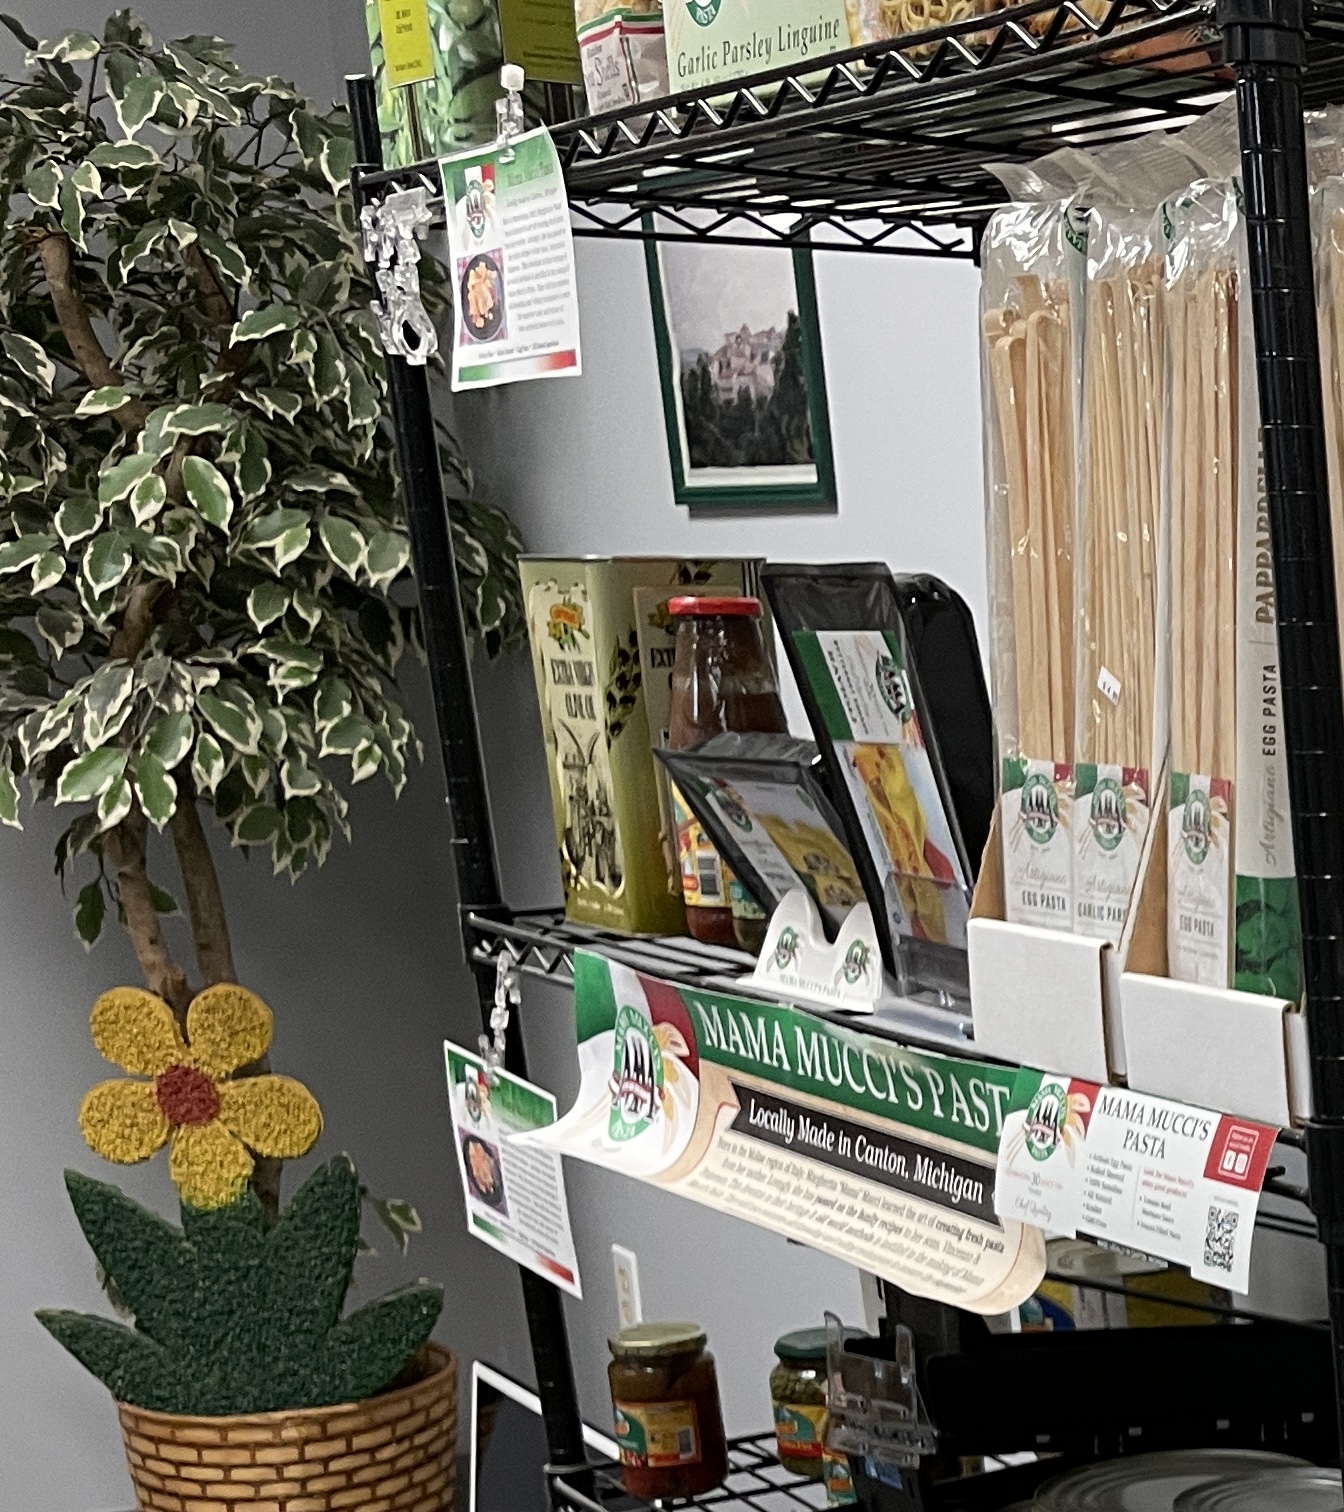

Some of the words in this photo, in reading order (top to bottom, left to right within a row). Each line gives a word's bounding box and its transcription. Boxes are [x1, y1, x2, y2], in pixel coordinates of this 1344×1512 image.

[678, 46, 718, 78] Garlic
[722, 35, 773, 66] Parsley
[778, 15, 840, 57] Linguine
[1263, 663, 1279, 718] PASTA
[1262, 720, 1278, 757] EGG
[1022, 890, 1038, 908] EGG
[1040, 893, 1067, 912] PASTA
[694, 1000, 791, 1073] MAMA
[794, 1025, 926, 1103] MUCCI'S
[924, 1059, 1010, 1139] PAST
[1098, 1095, 1145, 1125] MAMA
[1147, 1107, 1213, 1142] MUCCI'S
[749, 1099, 796, 1145] Locally
[797, 1115, 835, 1152] Made
[838, 1130, 852, 1159] in
[855, 1136, 910, 1181] Canton,
[913, 1154, 984, 1205] Michigan
[1122, 1130, 1167, 1160] PASTA
